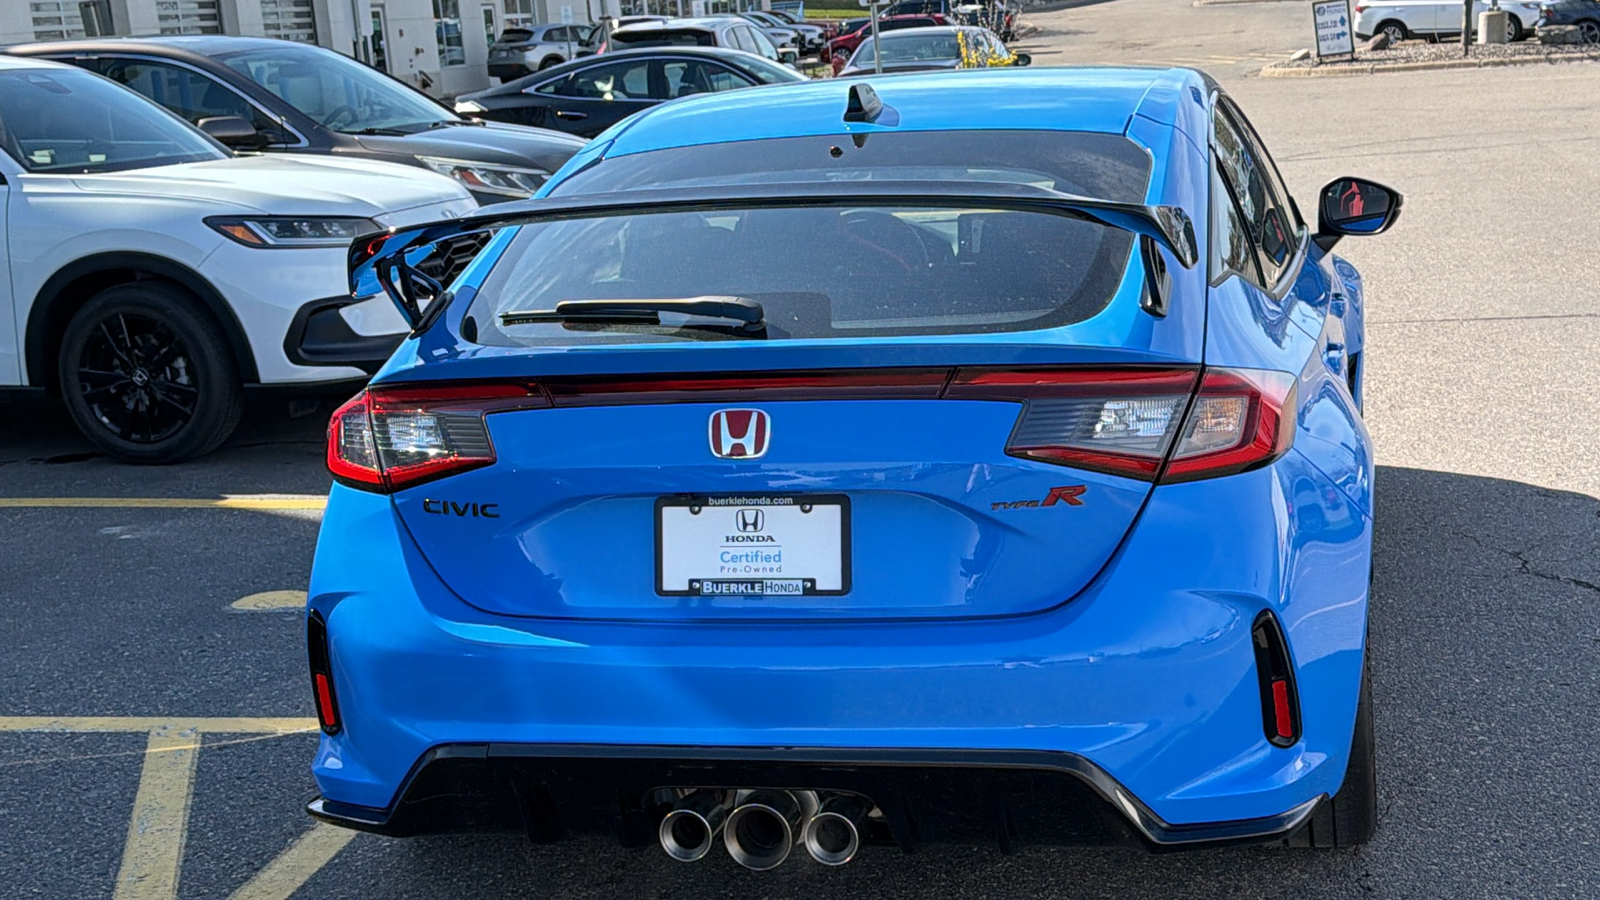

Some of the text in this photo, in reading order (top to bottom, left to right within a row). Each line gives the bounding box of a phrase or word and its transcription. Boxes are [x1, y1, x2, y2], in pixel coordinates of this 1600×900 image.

[708, 496, 793, 506] buerklehonda.com
[991, 485, 1087, 510] TYPE R
[423, 498, 500, 518] CIVIC
[725, 535, 776, 543] HONDA
[720, 550, 782, 563] Certified
[720, 565, 782, 573] Pre-Owned
[702, 581, 801, 593] BUERKLE HONDA
